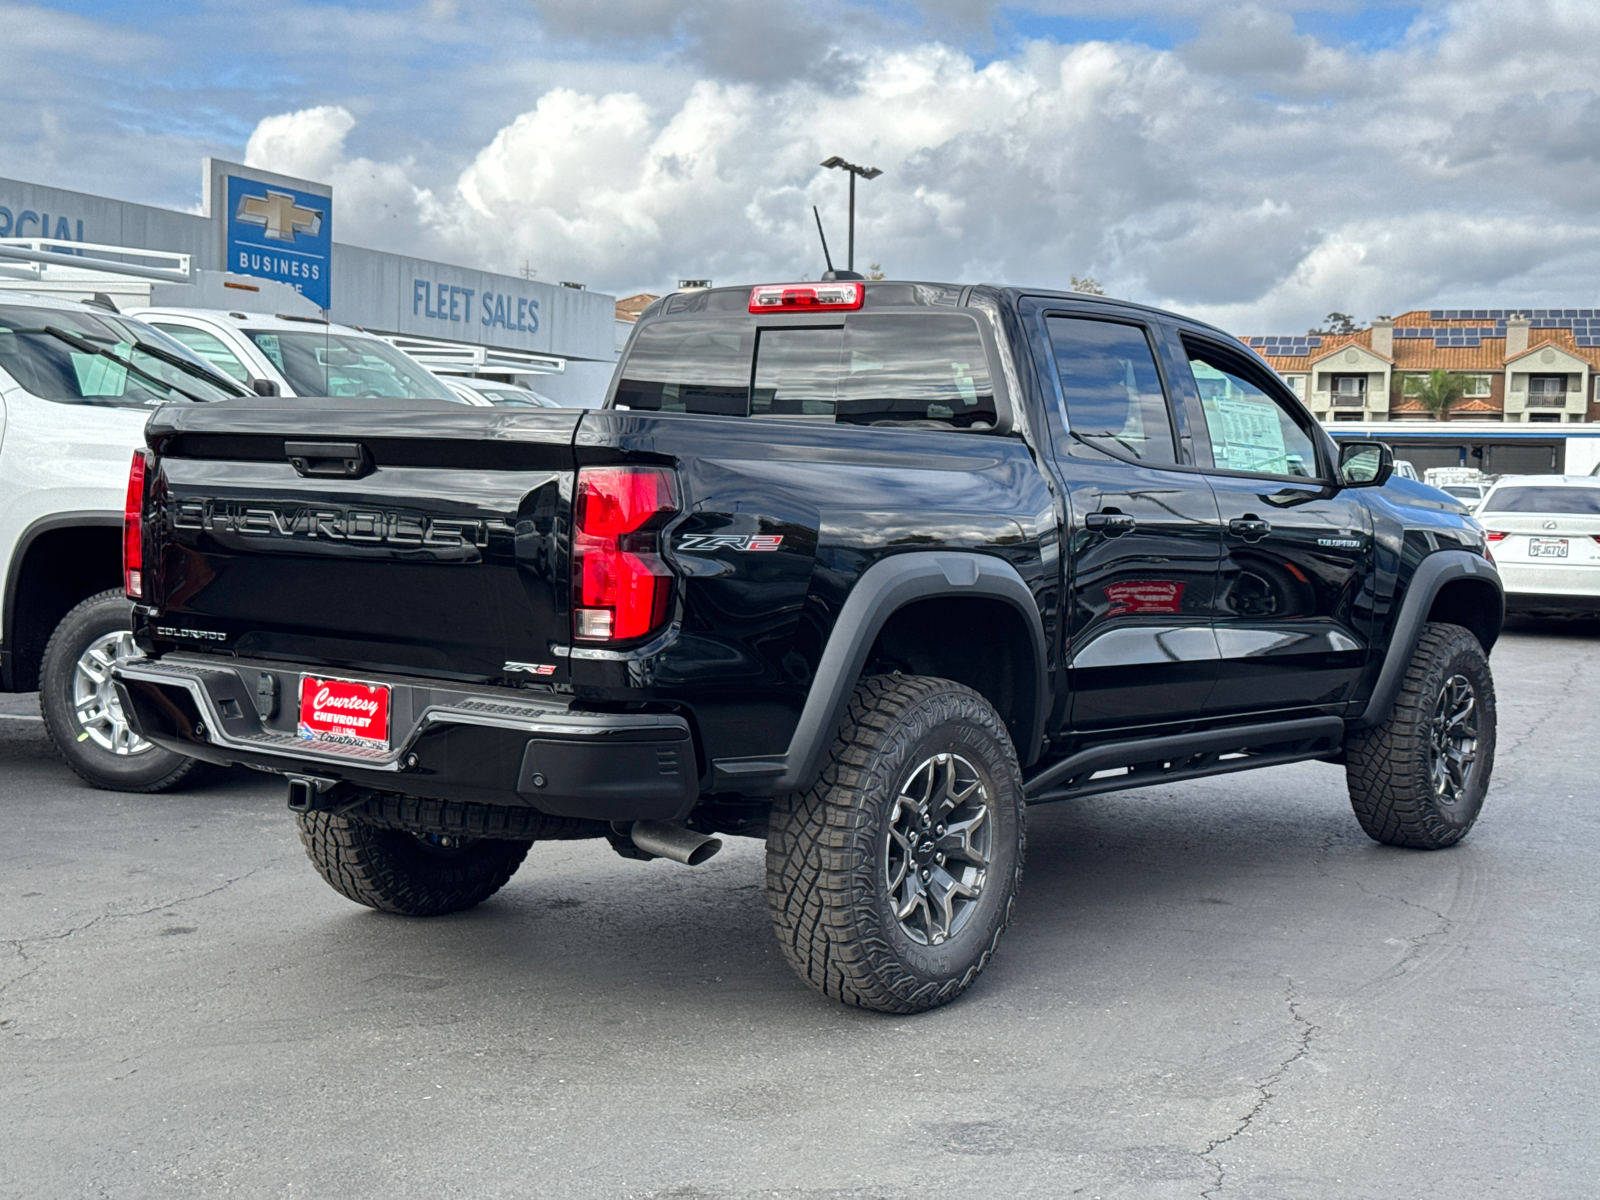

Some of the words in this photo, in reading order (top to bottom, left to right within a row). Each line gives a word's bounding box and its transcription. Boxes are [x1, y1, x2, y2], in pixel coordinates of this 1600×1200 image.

[240, 252, 320, 280] BUSINESS
[414, 279, 475, 323] FLEET
[482, 291, 540, 333] SALES
[173, 498, 506, 548] CHEVROLET
[677, 533, 784, 551] ZR2
[157, 626, 228, 641] COLORADO
[502, 661, 557, 675] ZR2
[313, 687, 378, 716] Courtesy
[313, 711, 371, 727] CHEVROLET
[954, 726, 1017, 825] WRANGLER
